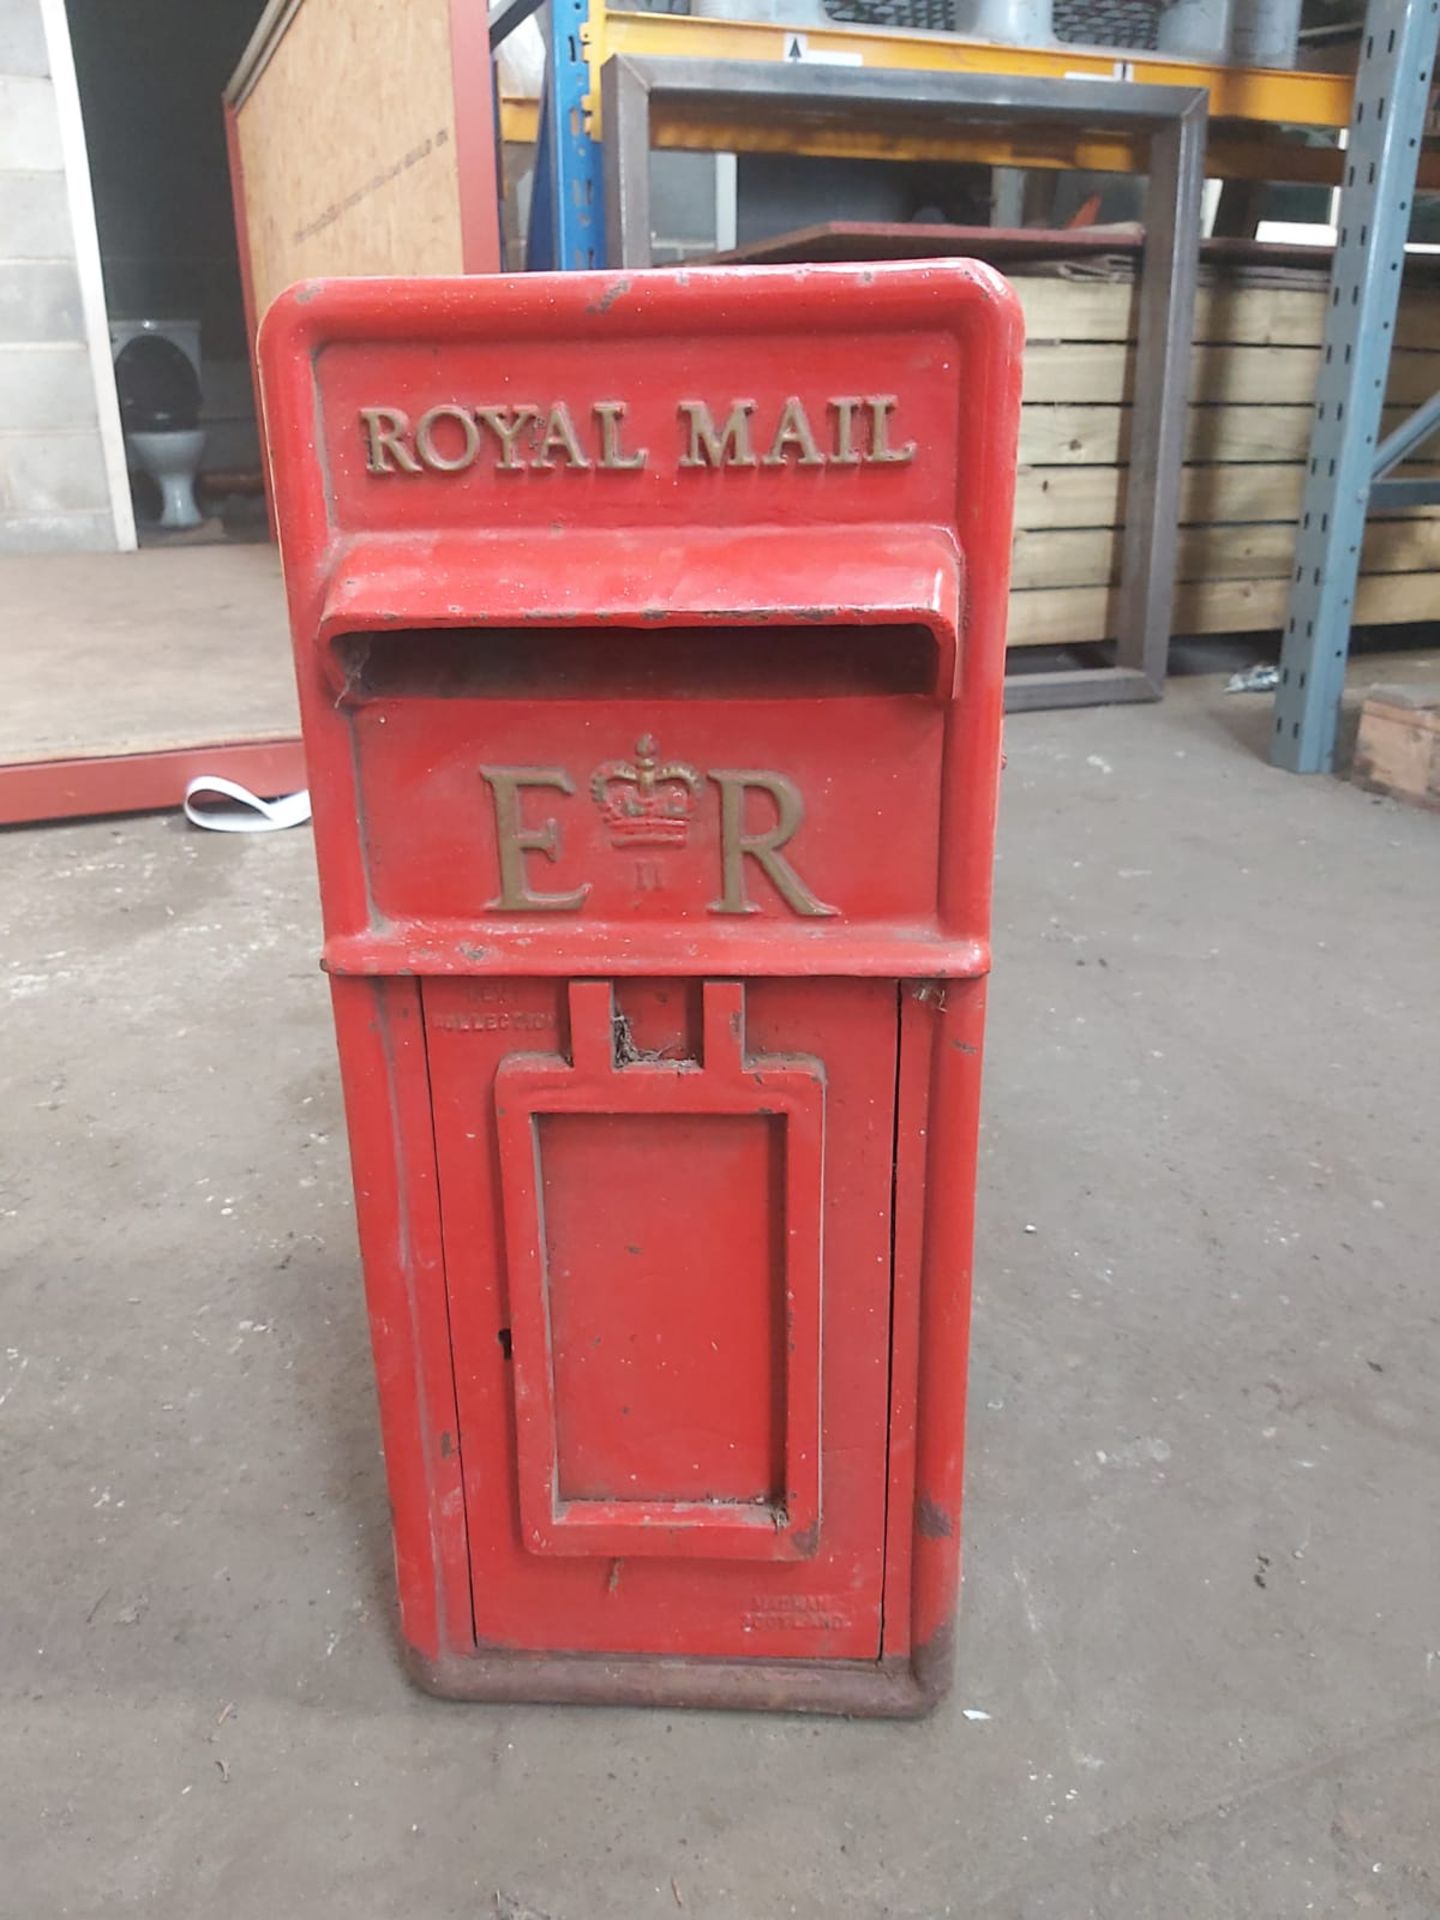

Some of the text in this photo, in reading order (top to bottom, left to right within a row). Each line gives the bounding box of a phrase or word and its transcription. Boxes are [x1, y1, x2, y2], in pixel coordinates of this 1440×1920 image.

[359, 394, 917, 473] ROYAL MAIL
[479, 764, 841, 917] E R
